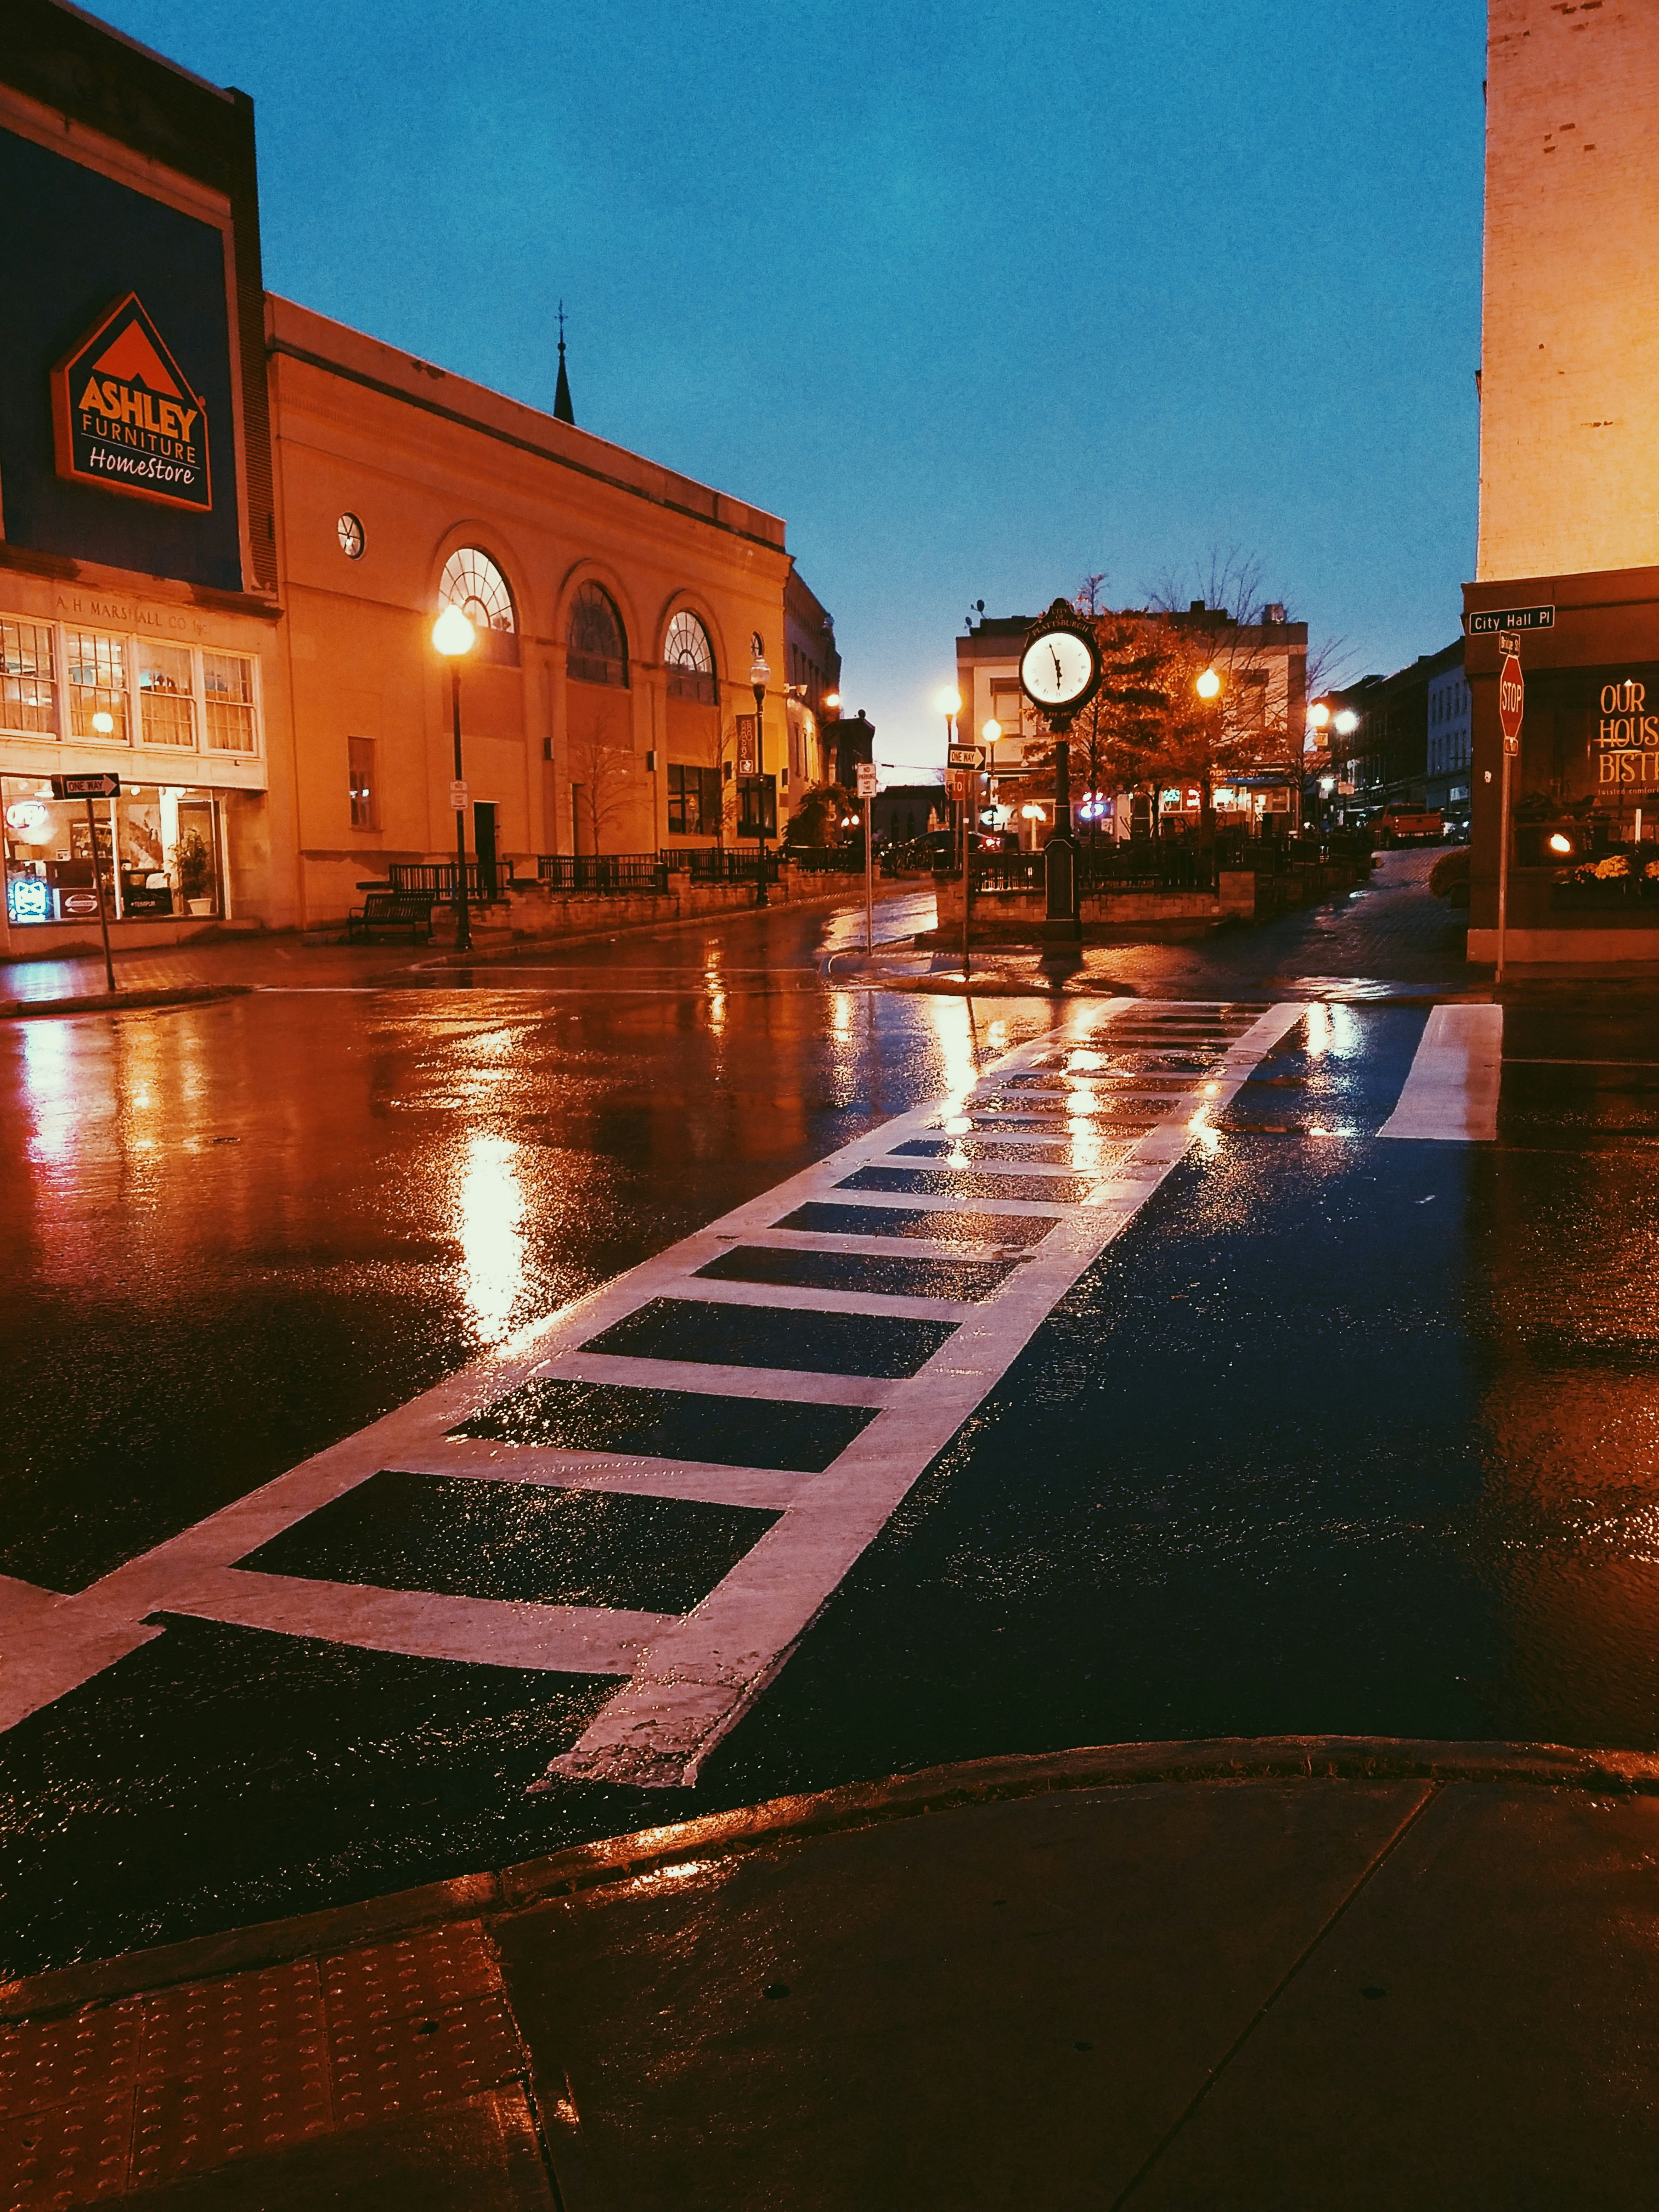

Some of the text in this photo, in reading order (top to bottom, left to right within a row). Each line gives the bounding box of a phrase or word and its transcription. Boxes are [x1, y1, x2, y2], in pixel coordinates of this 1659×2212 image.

[78, 376, 198, 443] ASHLEY
[83, 414, 195, 464] FURNITURE
[90, 447, 194, 484] HomeStore
[91, 601, 162, 626] MARSHALL
[1475, 611, 1550, 630] City Hall Pl
[1032, 619, 1089, 636] PLATTSBURGH
[1501, 636, 1513, 653] Bridge
[1502, 680, 1522, 713] STOP
[1600, 683, 1645, 713] OUR
[951, 751, 975, 763] ONE WAY
[68, 781, 103, 792] ONE WAY
[1598, 787, 1625, 795] twisted
